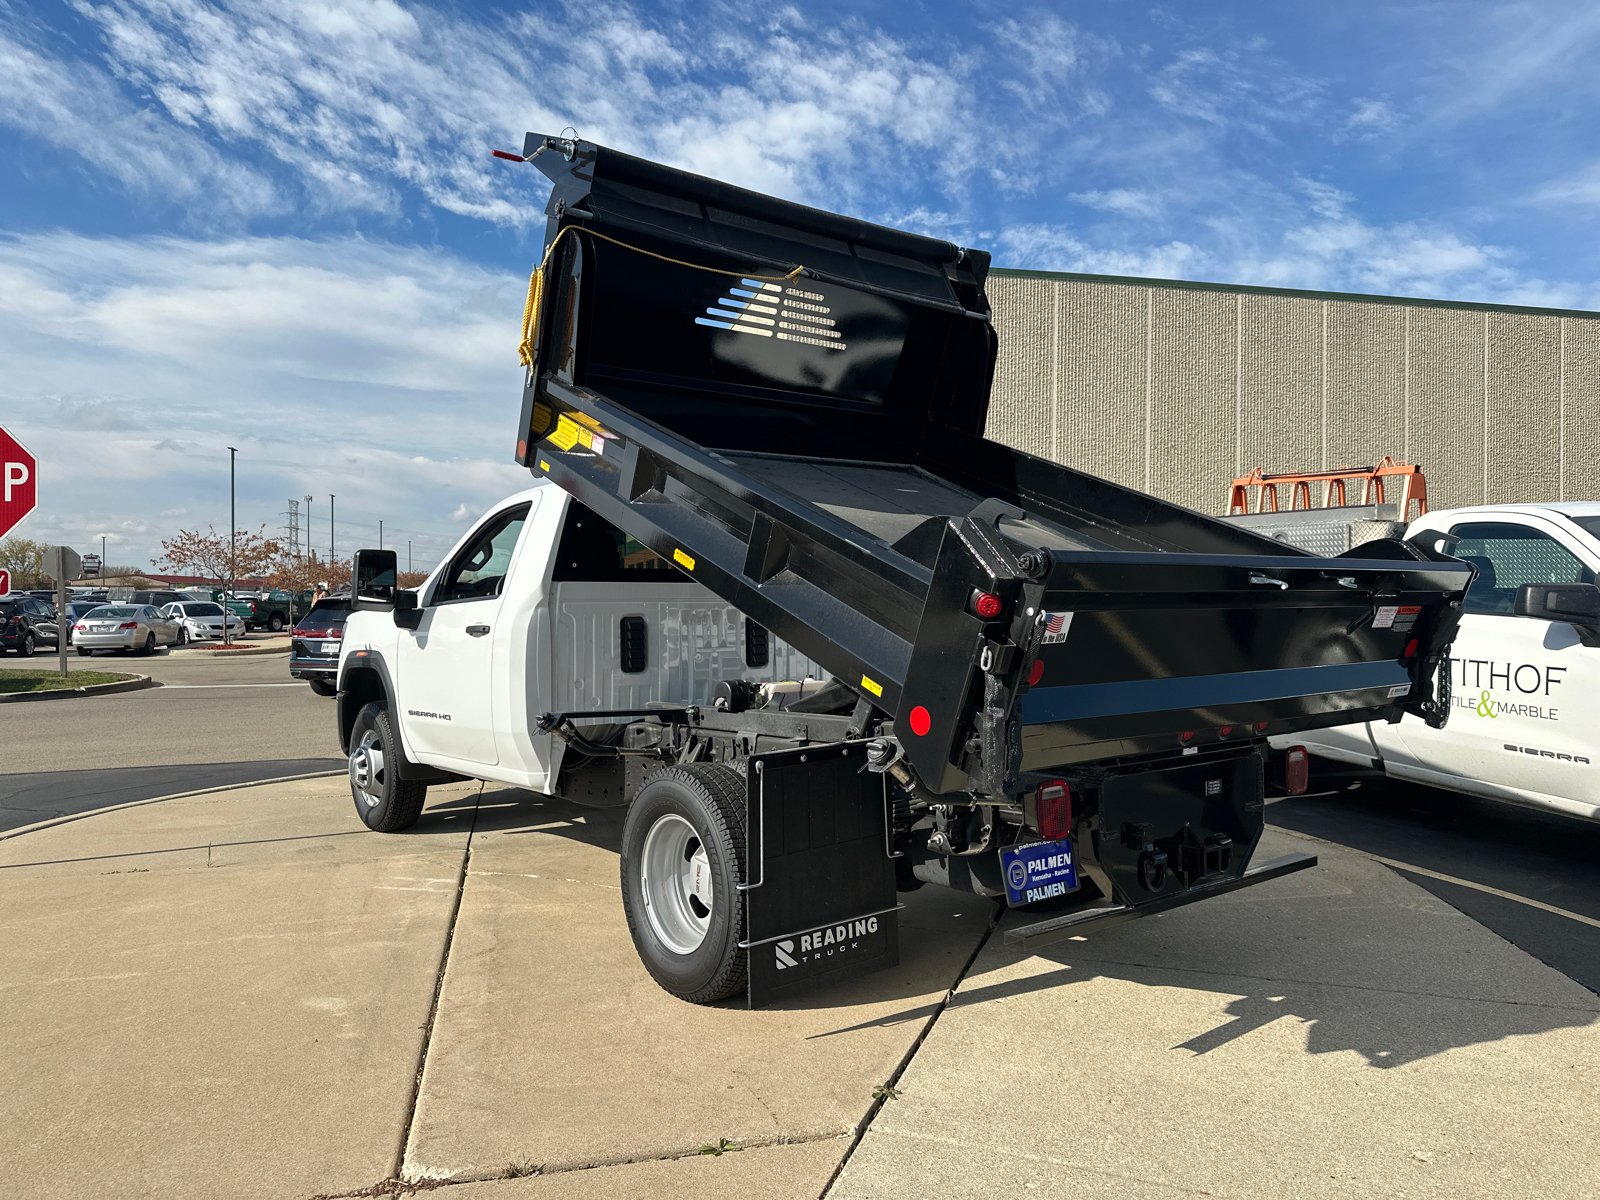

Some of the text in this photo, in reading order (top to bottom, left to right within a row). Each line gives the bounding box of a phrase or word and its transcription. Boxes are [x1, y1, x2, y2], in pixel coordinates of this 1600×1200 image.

[408, 709, 452, 721] SIERRA HD
[1497, 701, 1559, 721] MARBLE
[1503, 743, 1590, 765] SIERRA
[1028, 853, 1071, 873] PALMEN
[1032, 872, 1052, 882] Kenosha
[1054, 868, 1070, 877] Racine
[1027, 882, 1065, 902] PALMEN
[800, 916, 878, 953] READING
[801, 941, 859, 963] TRUCK
